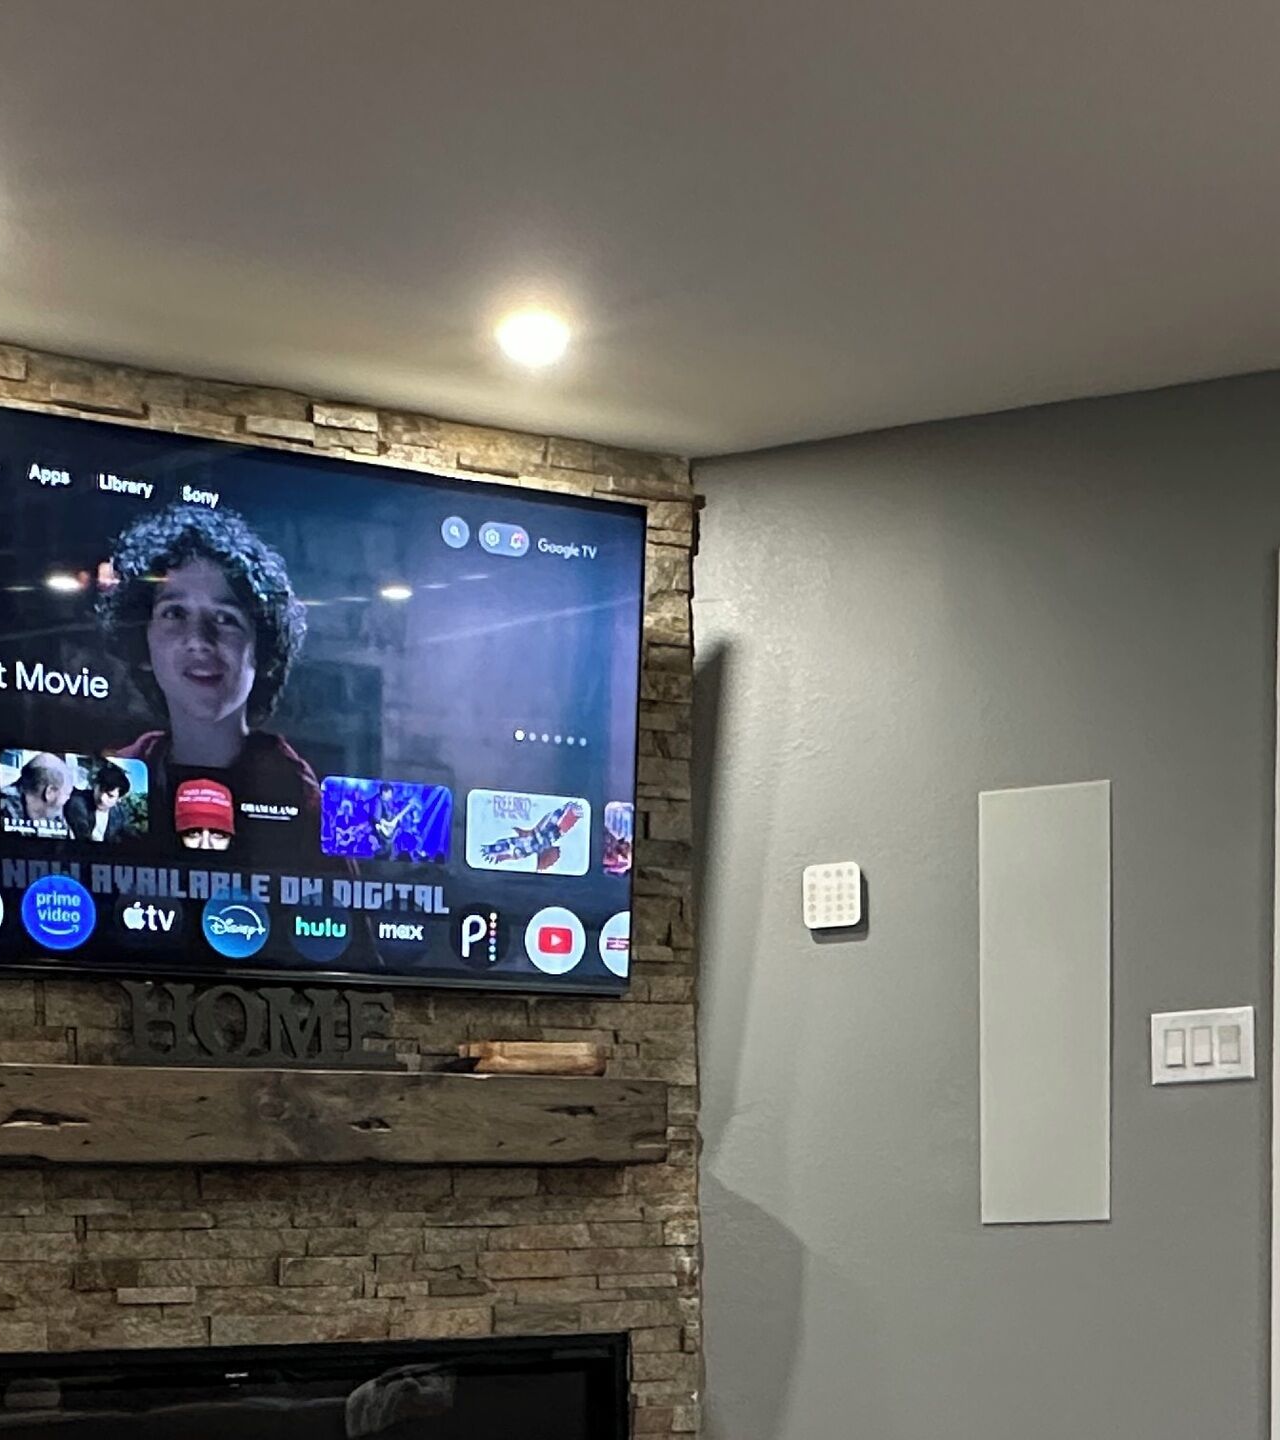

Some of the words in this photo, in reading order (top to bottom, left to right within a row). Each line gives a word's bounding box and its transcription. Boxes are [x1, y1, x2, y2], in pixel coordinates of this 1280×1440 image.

[28, 463, 71, 486] Apps
[99, 473, 154, 499] Library
[182, 485, 219, 509] Sony
[538, 538, 580, 559] Google
[581, 545, 597, 559] TV
[15, 661, 109, 699] Movie
[35, 891, 81, 908] prime
[91, 864, 270, 903] AVAILABLE
[333, 879, 450, 914] DIGITAL
[37, 906, 81, 922] video
[144, 904, 176, 931] tv
[295, 916, 347, 938] hulu
[378, 922, 425, 941] max
[120, 979, 395, 1060] HOME
